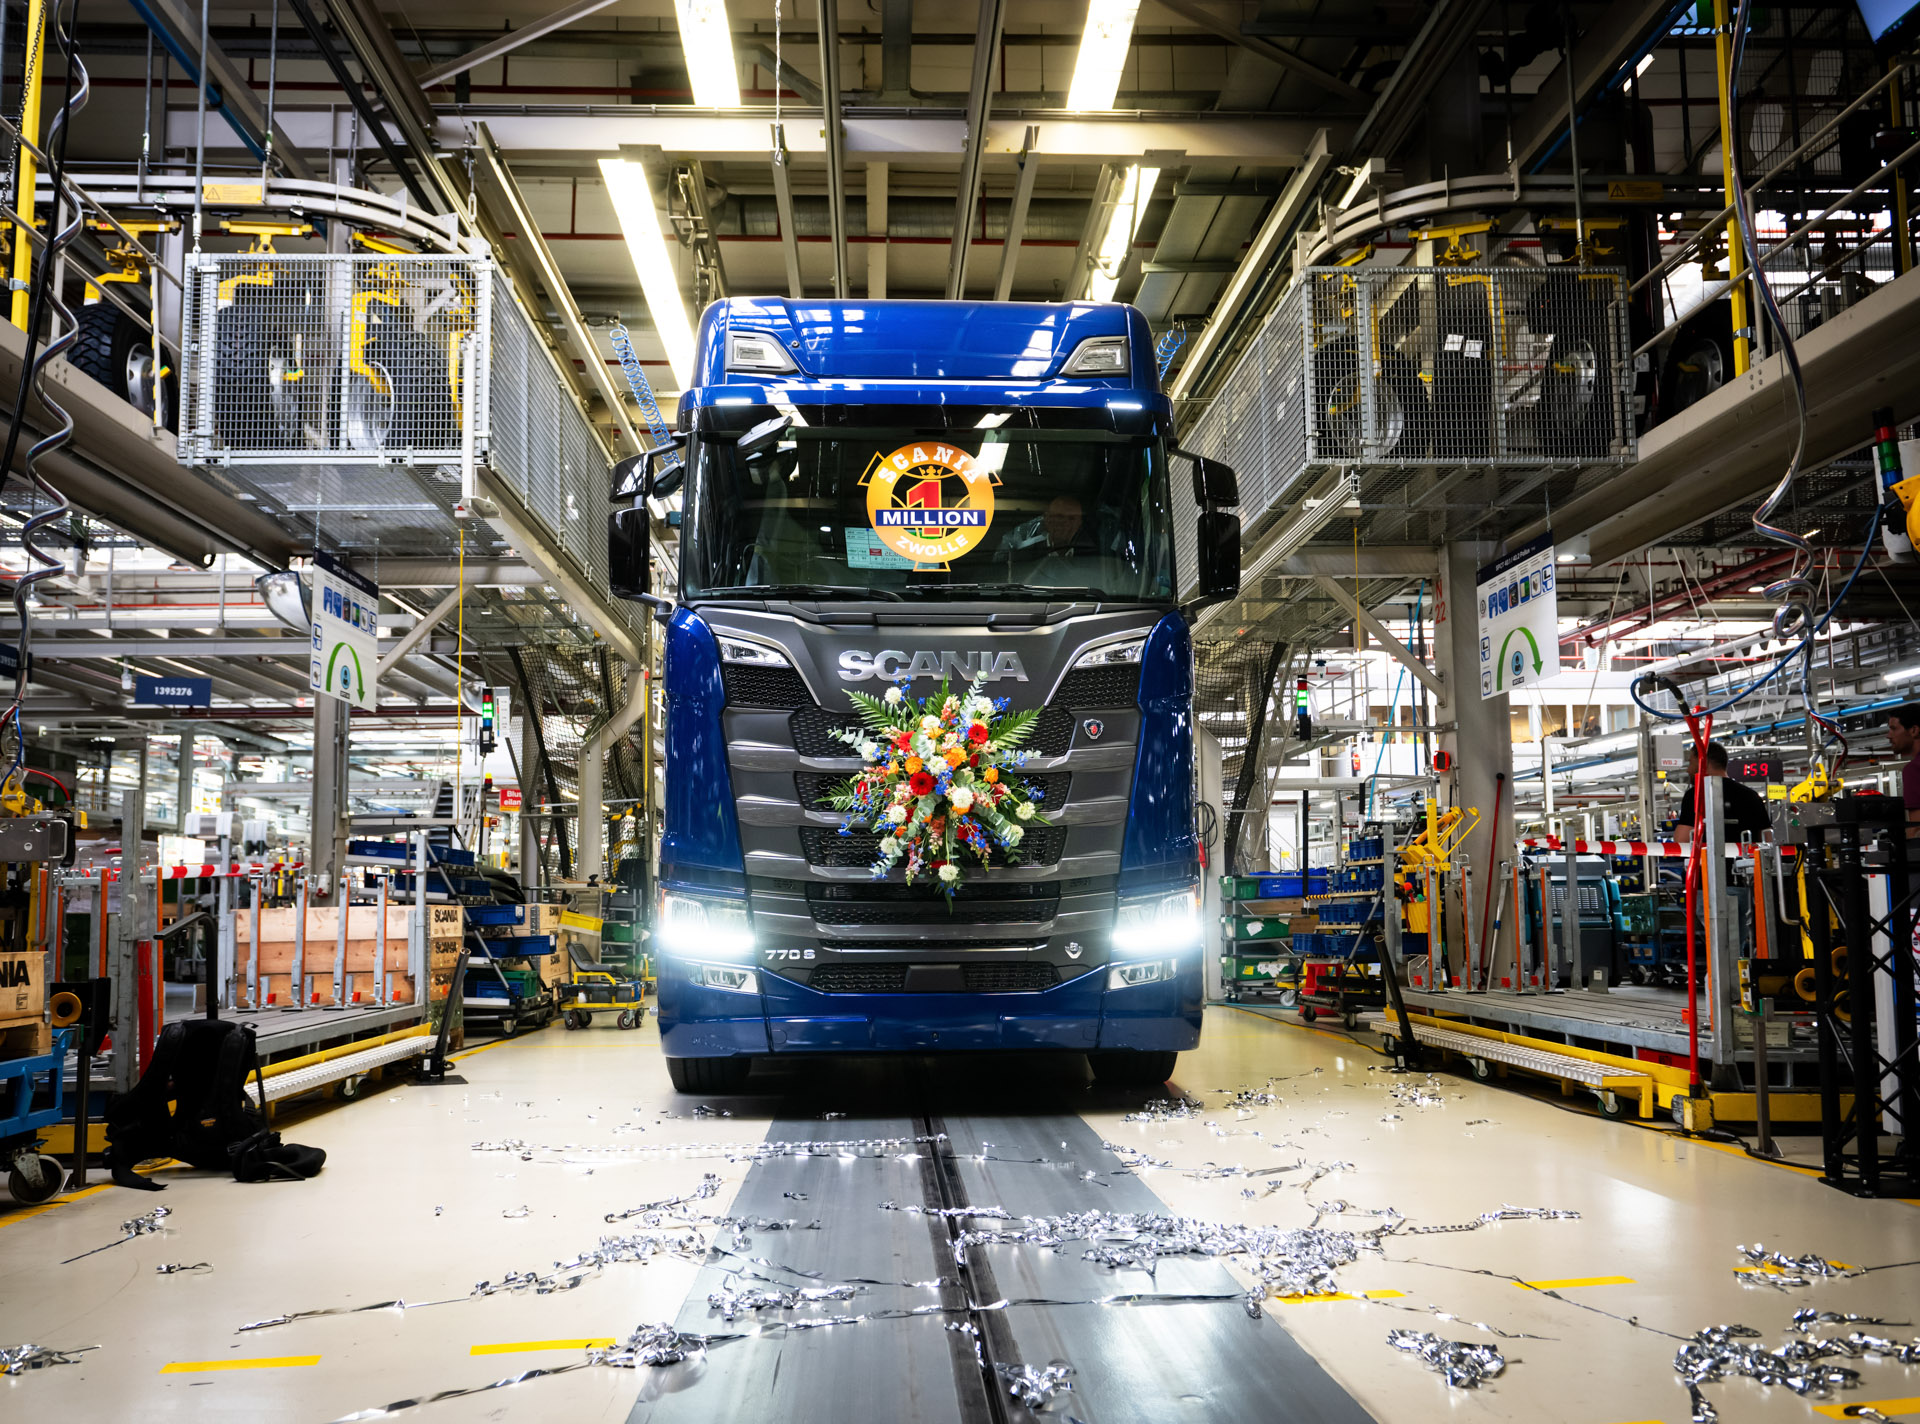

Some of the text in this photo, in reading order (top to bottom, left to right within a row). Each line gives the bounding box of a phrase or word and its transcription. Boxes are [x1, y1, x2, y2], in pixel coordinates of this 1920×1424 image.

[878, 445, 981, 484] SCANIA
[907, 479, 942, 537] 1
[882, 511, 979, 525] MILLION
[895, 534, 969, 557] ZWOLLE
[1435, 601, 1446, 624] 22
[837, 650, 1029, 682] SCANIA
[154, 686, 193, 697] 1395276
[1743, 763, 1768, 776] 1:59
[504, 798, 522, 806] eilan
[435, 909, 458, 923] SCANIA
[765, 949, 816, 960] 770 S
[435, 973, 453, 986] SCAN
